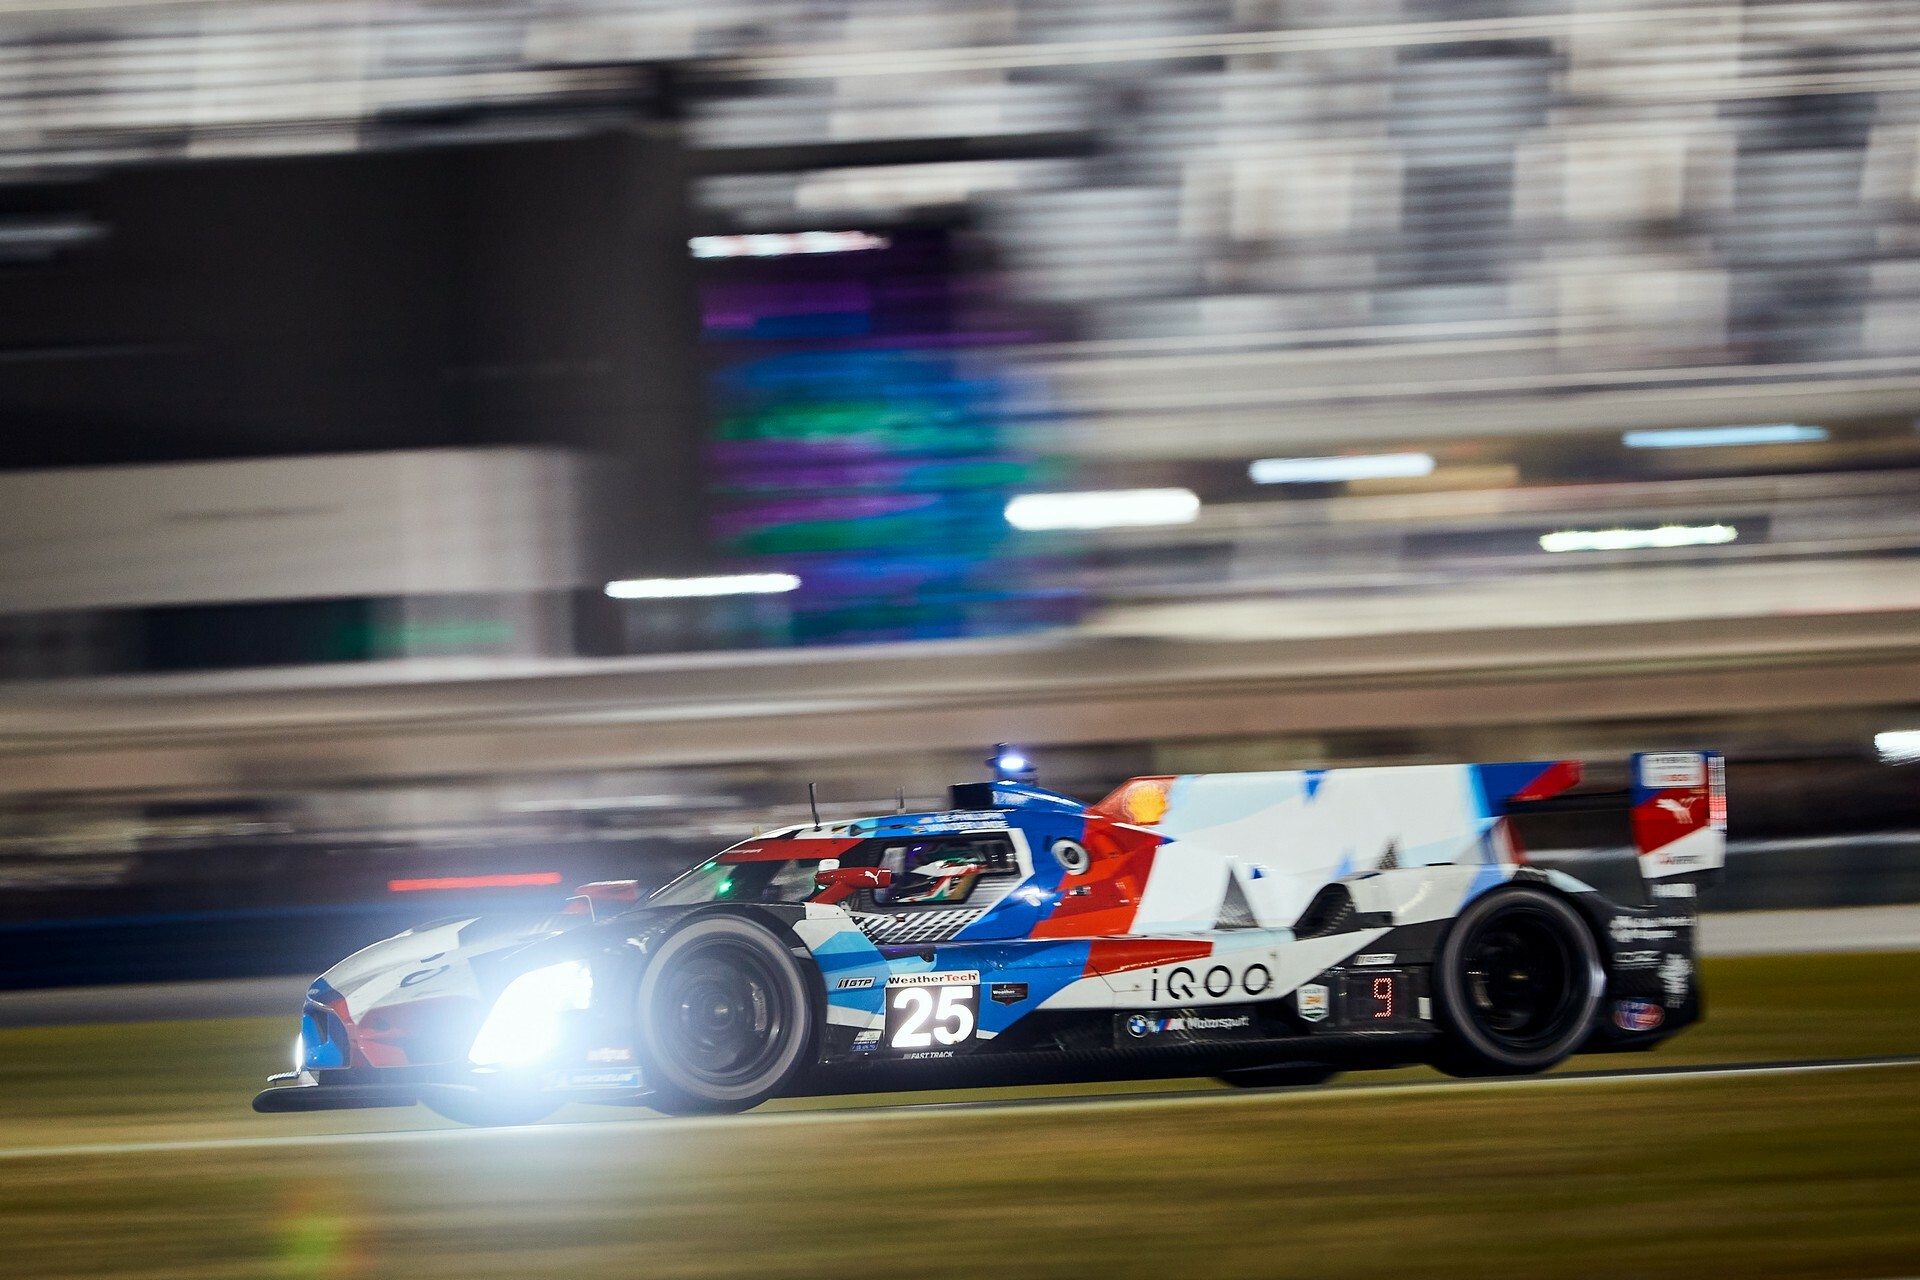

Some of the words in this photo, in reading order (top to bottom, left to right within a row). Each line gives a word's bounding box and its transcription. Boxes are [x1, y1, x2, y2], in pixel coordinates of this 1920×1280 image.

[889, 973, 977, 985] WeatherTech
[1373, 977, 1392, 1018] 9
[891, 986, 974, 1048] 25
